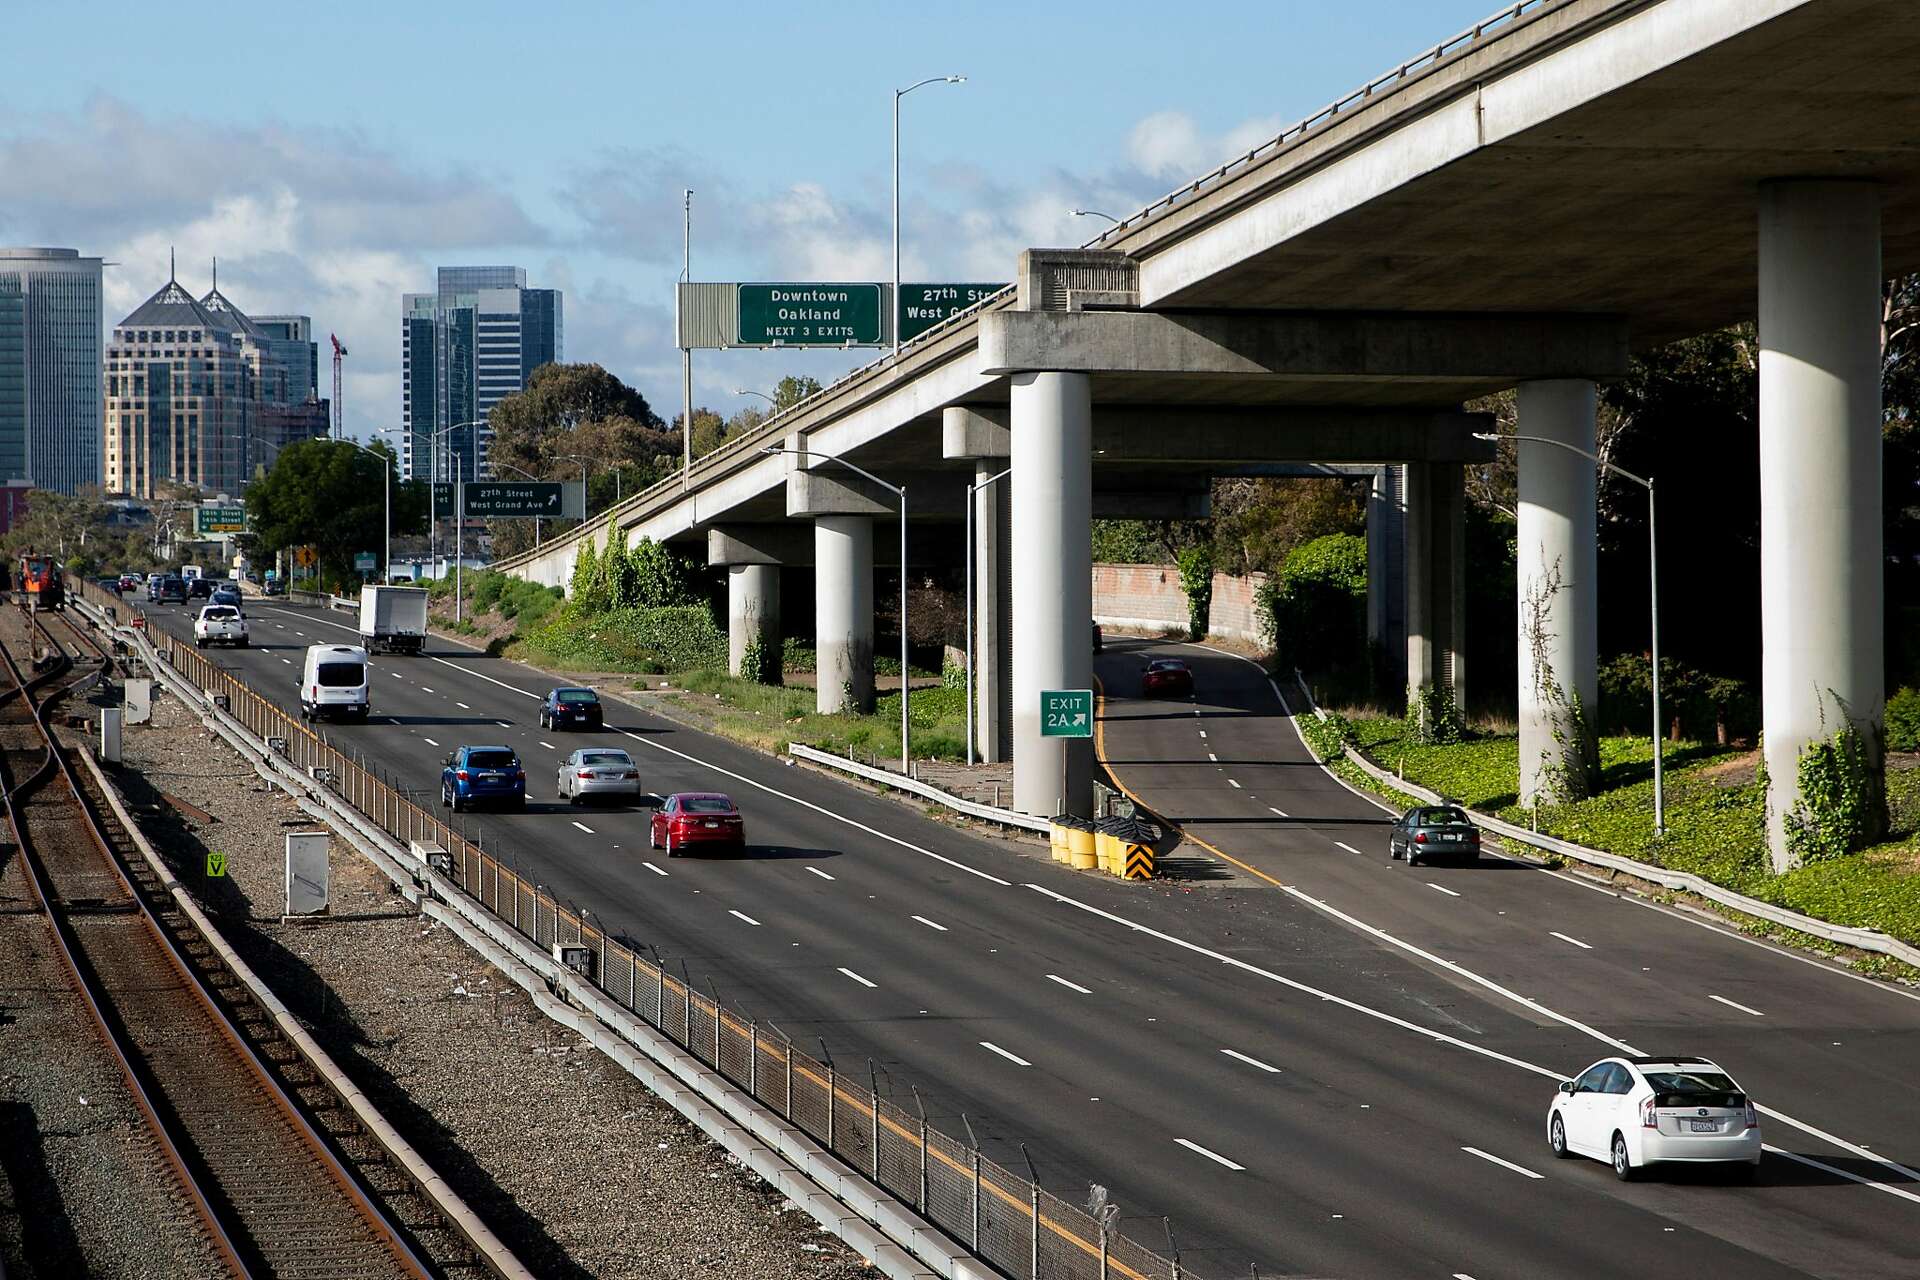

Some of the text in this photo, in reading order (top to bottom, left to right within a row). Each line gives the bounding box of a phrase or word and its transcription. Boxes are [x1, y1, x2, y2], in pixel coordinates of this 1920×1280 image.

[771, 290, 848, 302] Downtown
[923, 287, 957, 301] 27th
[778, 308, 841, 320] Oakland
[907, 306, 942, 318] West
[766, 326, 854, 336] NEXT 3 EXITS
[480, 489, 501, 497] 27th
[470, 501, 543, 509] West Grand Ave
[1050, 698, 1082, 710] EXIT
[1048, 713, 1069, 727] 2A
[210, 861, 223, 875] V
